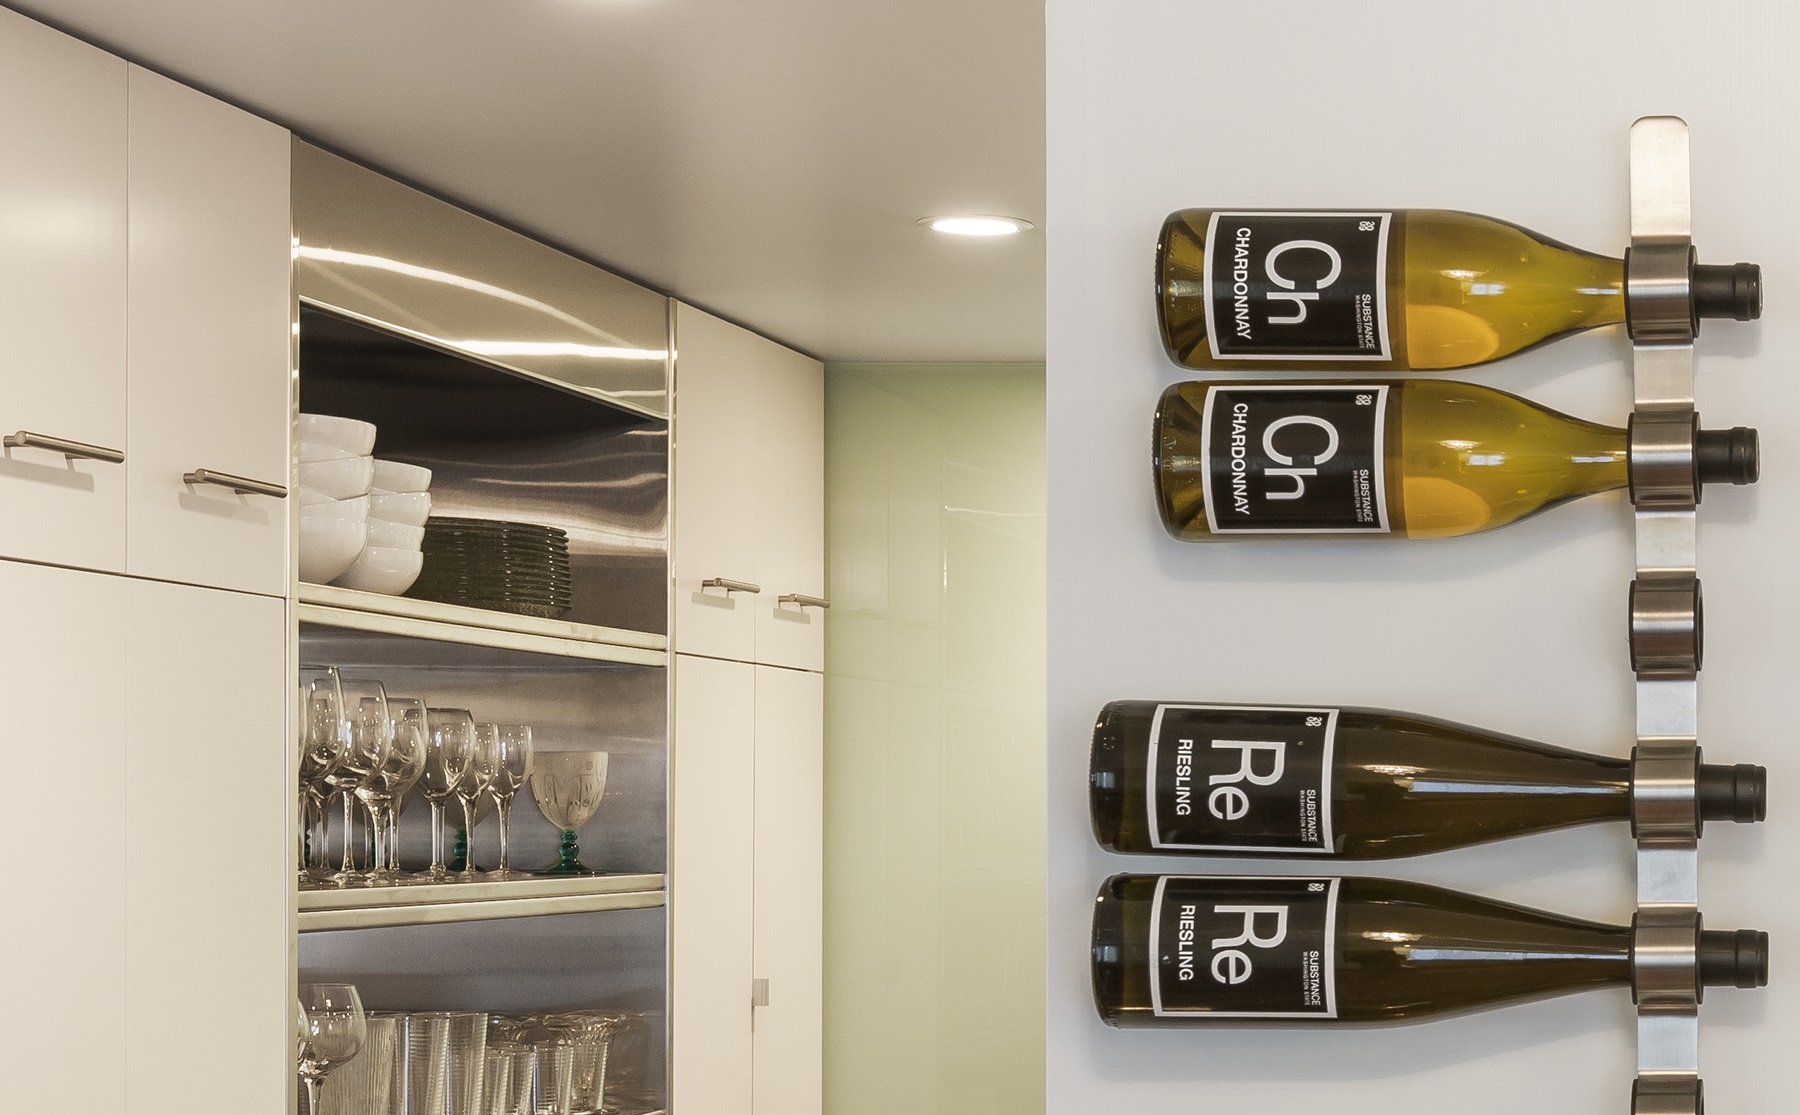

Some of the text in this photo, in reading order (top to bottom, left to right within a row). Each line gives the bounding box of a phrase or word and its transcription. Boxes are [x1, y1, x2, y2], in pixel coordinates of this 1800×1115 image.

[1233, 227, 1252, 340] CHARDONNAY
[1265, 239, 1342, 324] Ch
[1361, 293, 1376, 349] SUBSTANCE
[1231, 403, 1250, 515] CHARDONNAY
[1262, 415, 1339, 500] Ch
[1359, 469, 1374, 522] SUBSTANCE
[1176, 739, 1193, 816] RIESLING
[1208, 739, 1286, 821] Re
[1306, 789, 1318, 843] SUBSTANCE
[1178, 905, 1196, 981] RIESLING
[1211, 905, 1289, 985] Re
[1309, 950, 1321, 1006] SUBSTANCE
